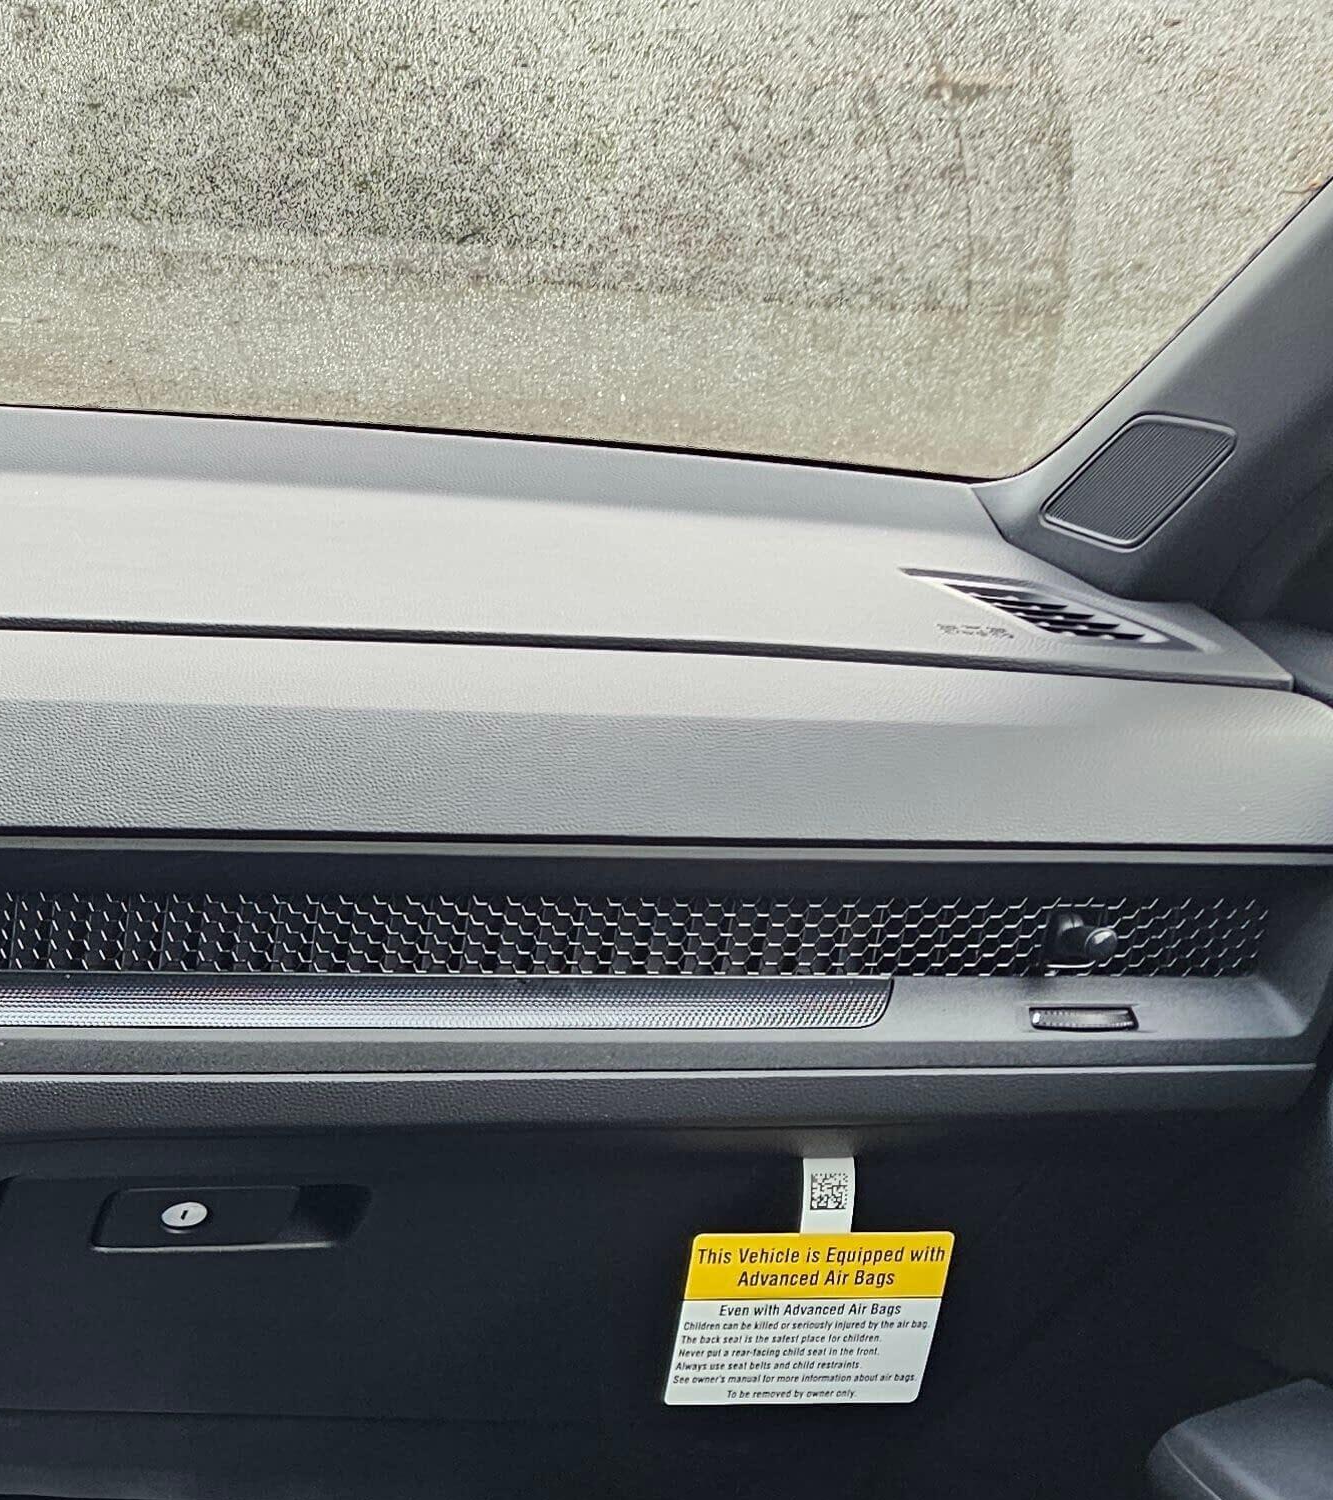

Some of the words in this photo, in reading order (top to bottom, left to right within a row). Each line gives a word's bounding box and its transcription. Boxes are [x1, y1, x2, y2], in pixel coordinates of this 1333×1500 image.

[697, 1248, 732, 1264] This
[739, 1247, 800, 1264] Vehicle
[806, 1247, 821, 1263] is
[826, 1246, 905, 1266] Equipped
[910, 1246, 945, 1262] with
[737, 1271, 820, 1287] Advanced
[824, 1270, 849, 1286] Air
[854, 1269, 895, 1289] Bags
[719, 1304, 750, 1317] Even
[753, 1304, 780, 1317] with
[783, 1303, 845, 1317] Advanced
[848, 1303, 867, 1316] Air
[870, 1303, 901, 1318] Bags
[683, 1321, 721, 1331] Children
[722, 1322, 739, 1331] can
[740, 1322, 752, 1331] be
[754, 1321, 779, 1330] killed
[781, 1322, 791, 1330] or
[792, 1321, 832, 1331] seriously
[835, 1320, 865, 1331] injured
[868, 1320, 878, 1331] by
[880, 1320, 895, 1329] the
[897, 1319, 910, 1329] air
[681, 1335, 697, 1344] The
[700, 1335, 720, 1344] back
[723, 1335, 742, 1344] seat
[755, 1335, 769, 1343] the
[772, 1334, 799, 1343] safest
[801, 1334, 825, 1344] place
[828, 1334, 840, 1342] for
[679, 1349, 705, 1358] Never
[707, 1349, 721, 1358] put
[732, 1348, 780, 1358] rear-facing
[782, 1348, 805, 1357] child
[807, 1348, 827, 1356] seat
[840, 1348, 854, 1356] the
[675, 1362, 707, 1372] Always
[710, 1363, 725, 1371] use
[728, 1362, 748, 1371] seat
[749, 1362, 770, 1371] belts
[773, 1362, 790, 1370] and
[792, 1361, 815, 1370] child
[672, 1375, 690, 1384] See
[692, 1375, 725, 1384] owner's
[727, 1374, 761, 1384] manual
[762, 1375, 774, 1384] for
[801, 1374, 852, 1383] information
[853, 1374, 878, 1382] about
[879, 1374, 892, 1382] air
[727, 1390, 736, 1398] To
[739, 1390, 750, 1399] be
[752, 1390, 792, 1398] removed
[794, 1390, 803, 1400] by
